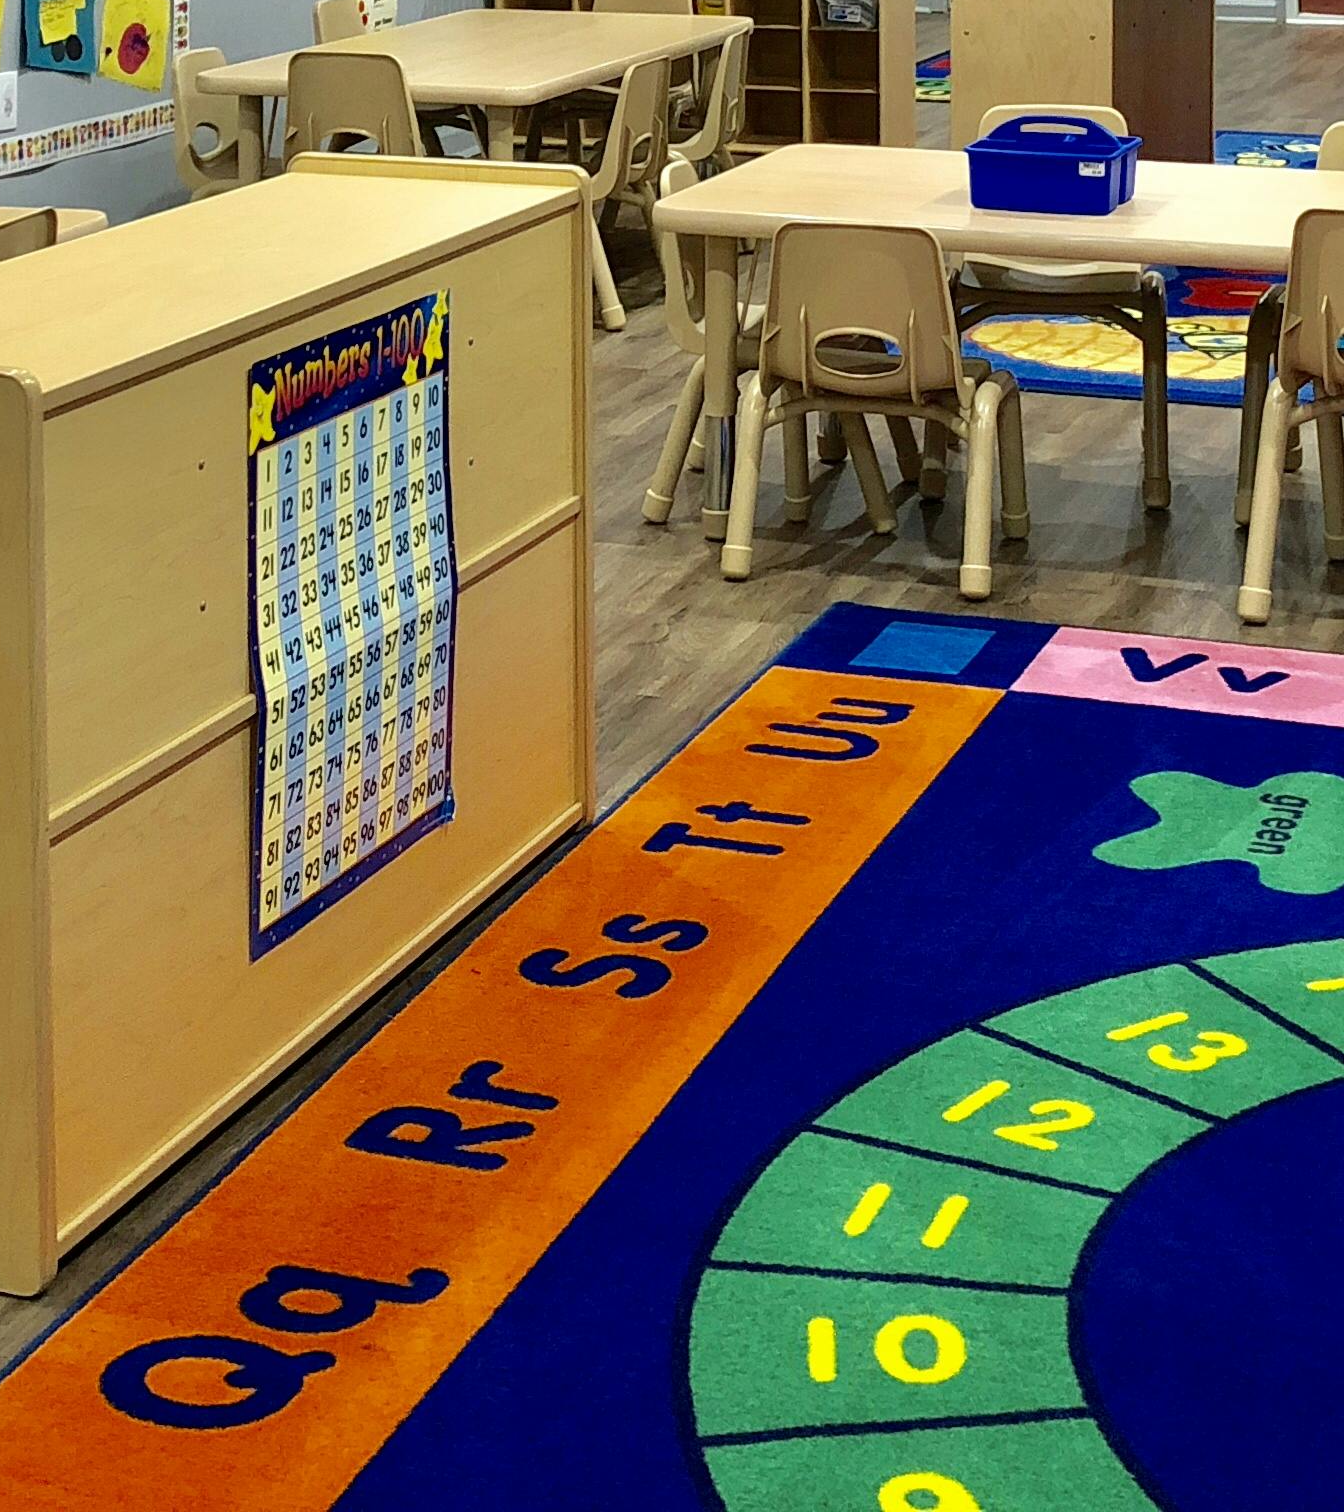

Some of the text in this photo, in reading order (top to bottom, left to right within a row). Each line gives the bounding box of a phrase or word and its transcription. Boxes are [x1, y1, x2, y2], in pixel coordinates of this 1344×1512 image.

[274, 307, 425, 421] Numbers 1-100
[263, 426, 441, 532] 11 12 13 14 15 16 17 18 19 20
[284, 450, 293, 475] 2
[304, 441, 313, 465] 3
[322, 432, 332, 454] 4
[341, 424, 350, 448] 5
[359, 416, 368, 439] 6
[378, 408, 387, 430] 7
[394, 400, 403, 423] 8
[412, 392, 421, 414] 9
[428, 384, 439, 408] 10
[261, 470, 443, 581] 21 22 23 24 25 26 27 28 29 30
[263, 512, 445, 628] 31 32 33 34 35 36 37 38 39 40
[265, 556, 449, 674] 41 42 43 44 45 46 47 48 49 50
[271, 598, 450, 724] 51 52 53 54 55 56 57 58 59 60
[269, 642, 448, 772] 61 62 63 64 65 66 67 68 69 70
[1120, 647, 1291, 693] Vv
[1246, 792, 1312, 857] green
[99, 695, 914, 1428] Qq Rr Ss Tt Uu
[1106, 1011, 1248, 1072] 13
[942, 1080, 1095, 1150] 12
[843, 1183, 969, 1248] 11
[806, 1314, 967, 1384] 10
